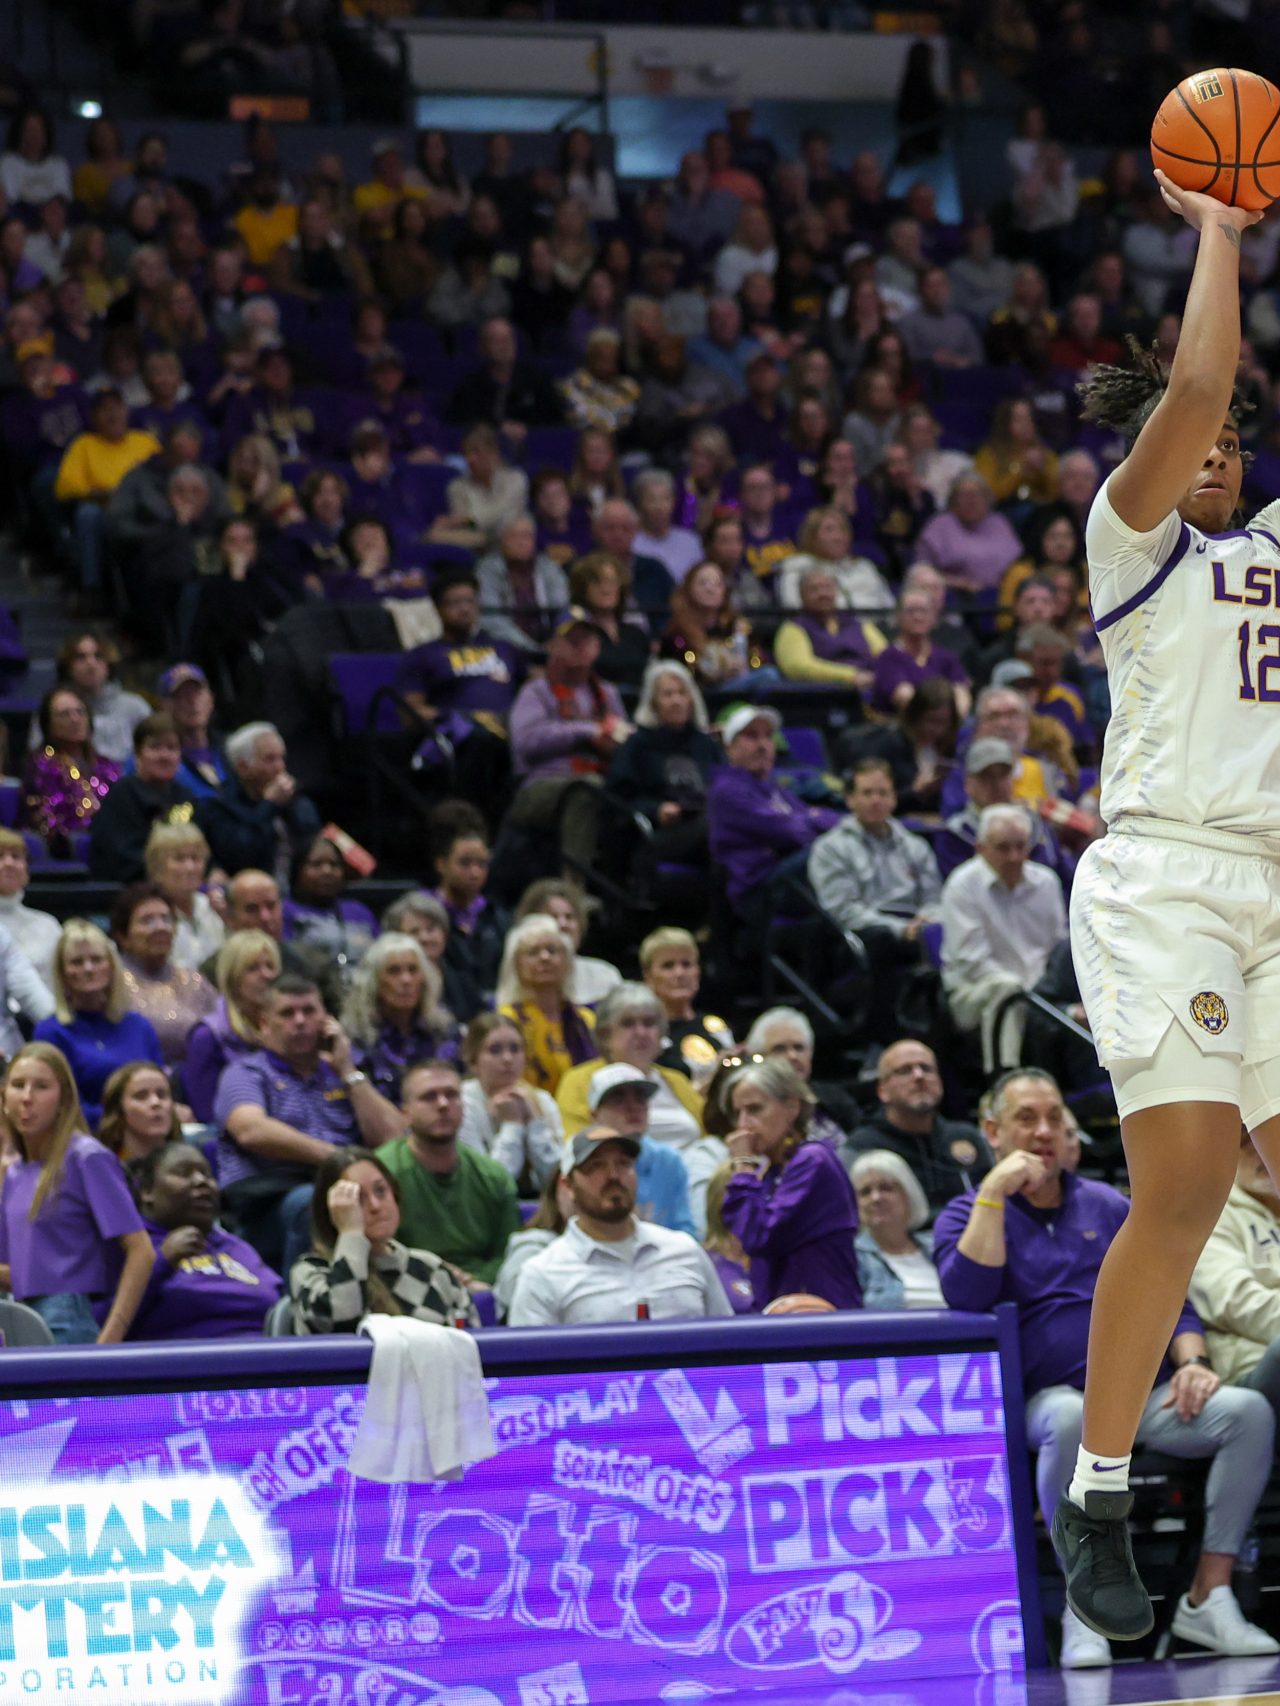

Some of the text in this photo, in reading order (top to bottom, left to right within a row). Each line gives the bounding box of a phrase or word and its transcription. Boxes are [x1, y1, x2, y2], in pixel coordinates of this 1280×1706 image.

[488, 1402, 552, 1441] ast
[553, 1375, 646, 1428] PLAY
[763, 1359, 943, 1446] Pick
[951, 1353, 1003, 1426] 4
[560, 1448, 653, 1495] SCRATCH
[653, 1474, 725, 1520] OFFS
[749, 1458, 1006, 1564] PICK 3
[259, 1613, 406, 1651] POWER
[0, 1659, 220, 1693] ORATION
